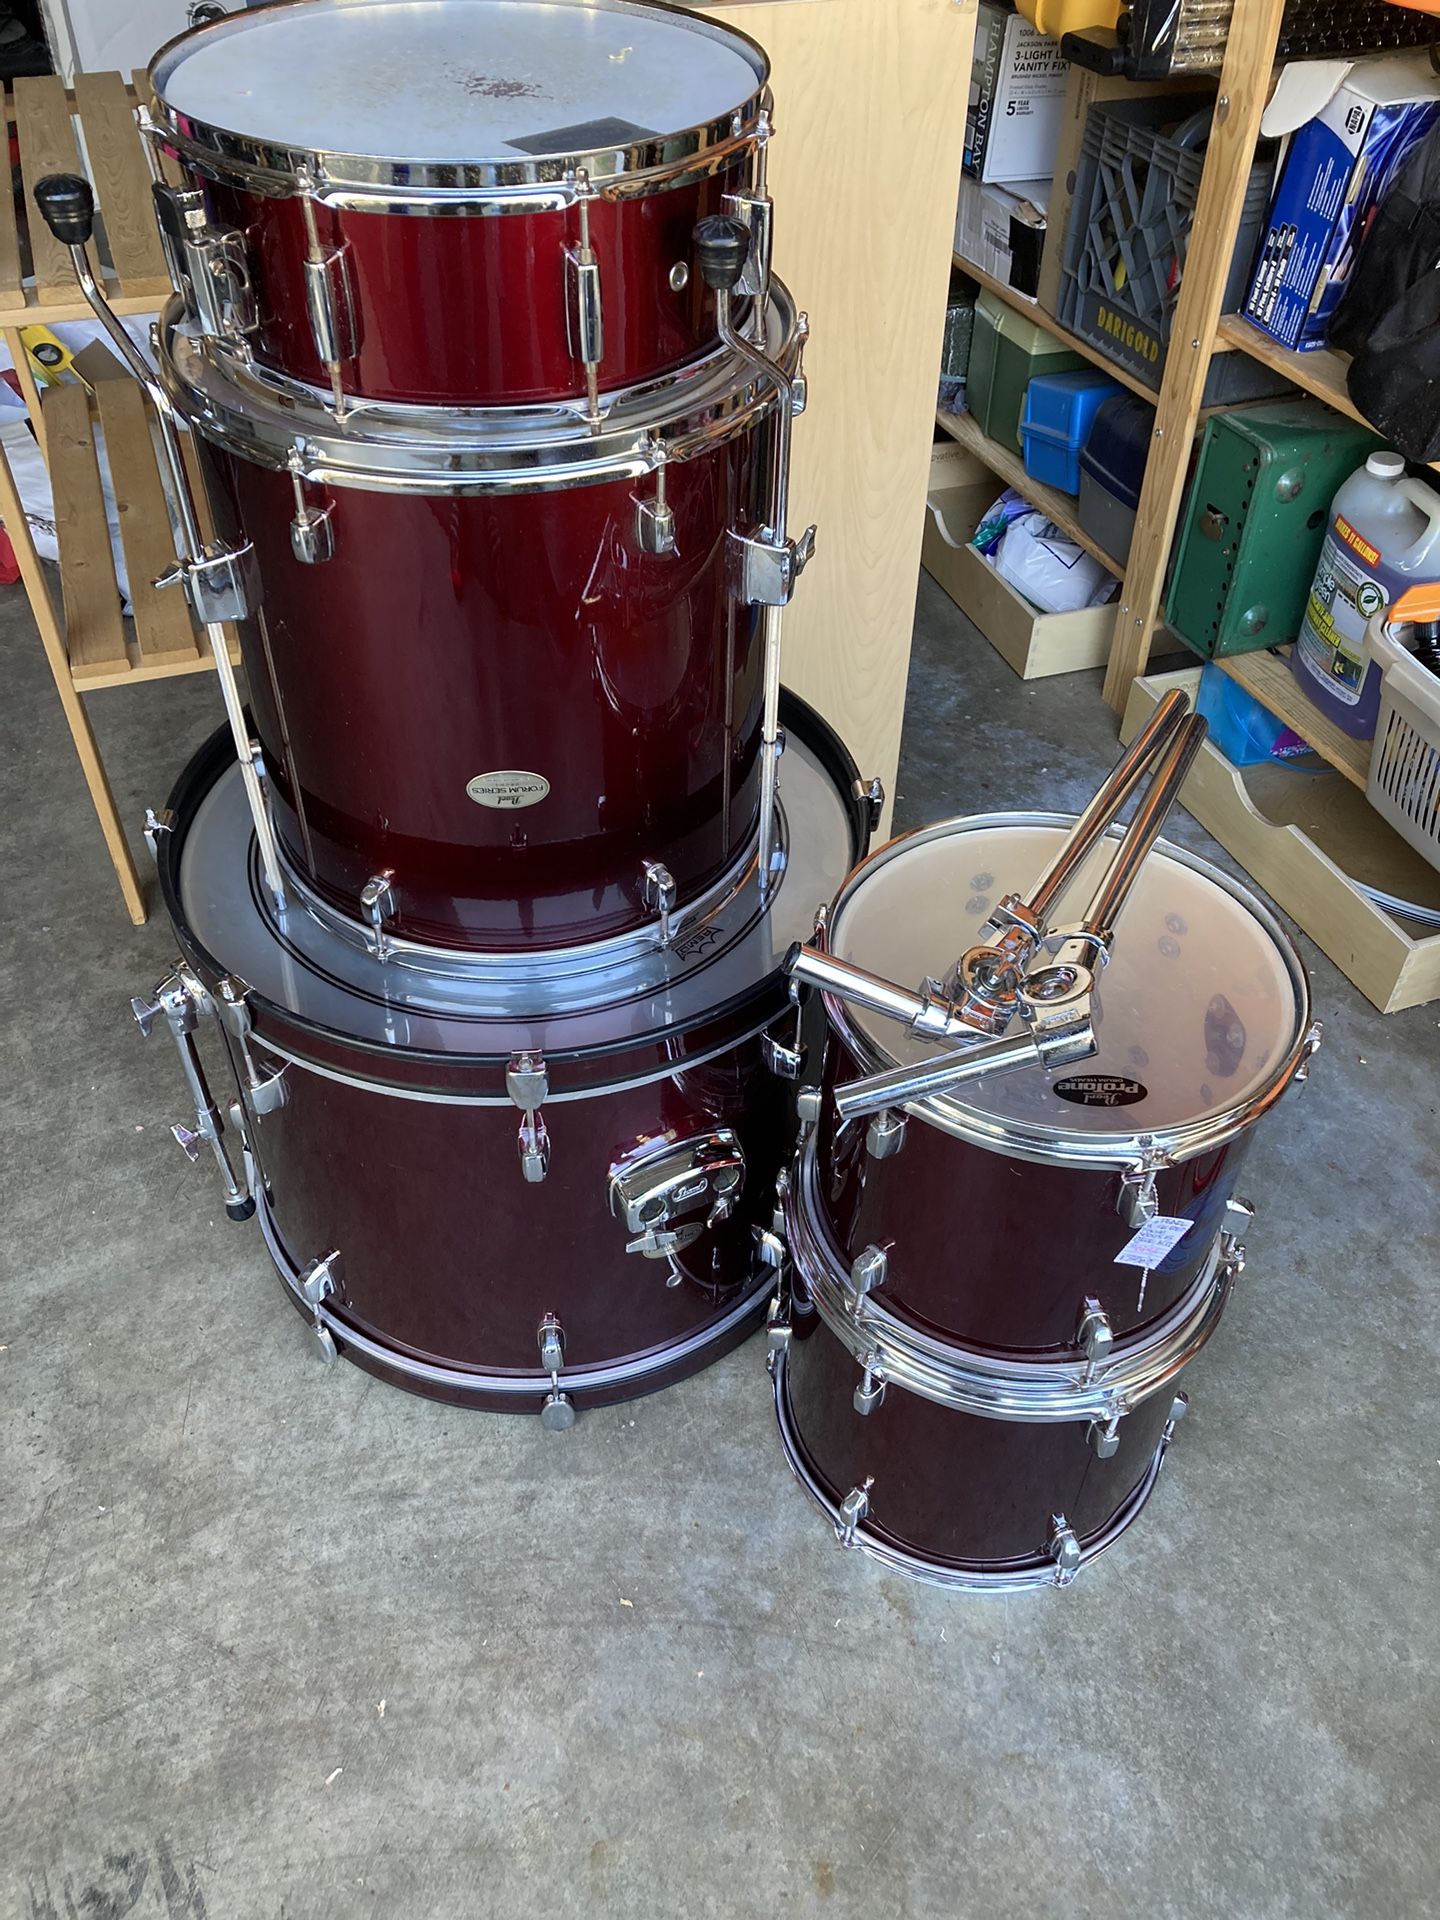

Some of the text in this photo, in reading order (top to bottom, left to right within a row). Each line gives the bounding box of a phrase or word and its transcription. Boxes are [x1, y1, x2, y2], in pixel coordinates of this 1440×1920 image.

[1015, 50, 1052, 61] 3-LIGHT
[1013, 61, 1049, 72] VANITY
[972, 22, 1000, 169] HAMPTON BAY
[1006, 100, 1017, 116] 5
[1349, 109, 1362, 131] NAPA
[1097, 306, 1159, 362] DARIGOLD
[508, 784, 544, 793] FORUM
[497, 795, 524, 805] Pearl
[680, 929, 712, 955] REMO
[1057, 1082, 1139, 1094] ProTone
[1082, 1091, 1122, 1106] Pearl
